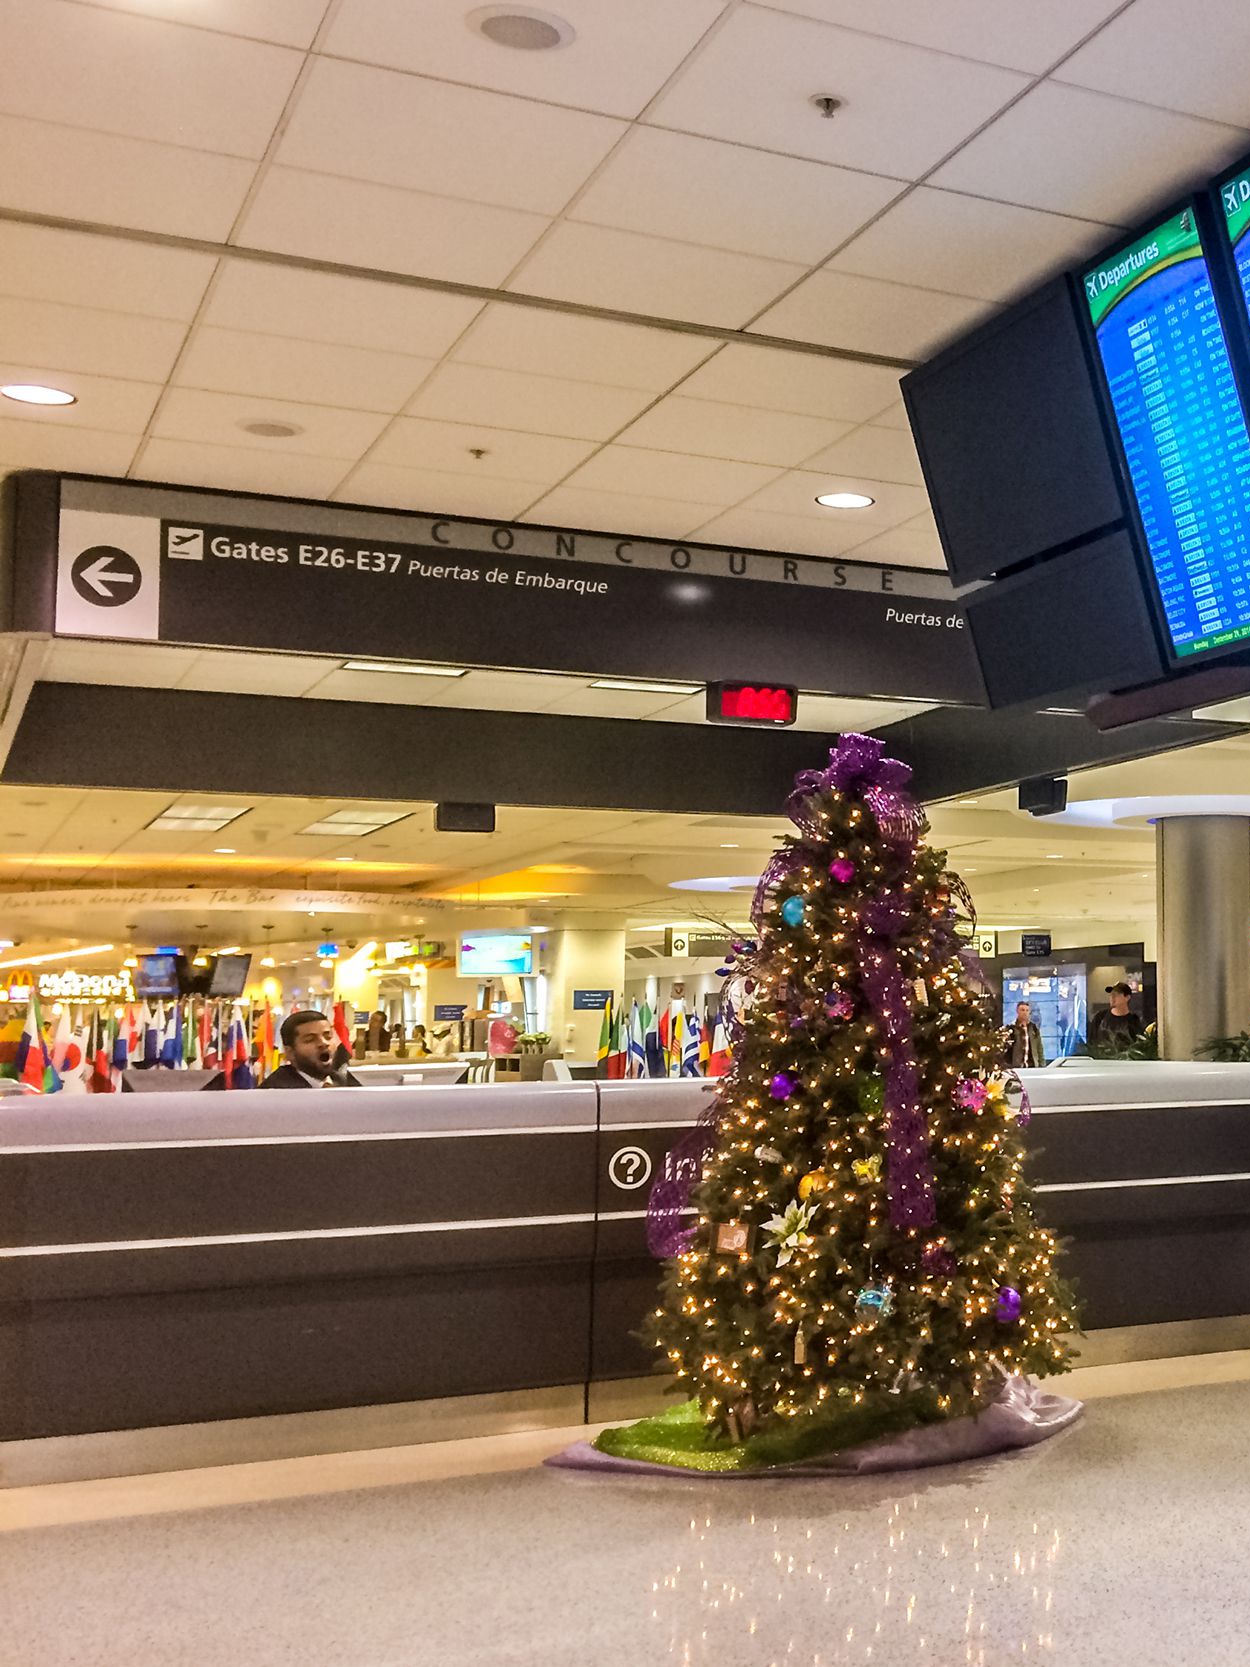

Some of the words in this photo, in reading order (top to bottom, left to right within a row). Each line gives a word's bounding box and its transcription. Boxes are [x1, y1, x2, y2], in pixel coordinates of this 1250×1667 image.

[1098, 241, 1159, 290] Departures
[210, 536, 289, 565] Gates
[298, 545, 402, 575] E26-E37
[407, 559, 480, 582] Puertas
[485, 567, 509, 584] de
[515, 570, 609, 596] Embarque
[431, 521, 894, 592] CONCOURSE
[885, 607, 942, 629] Puertas
[945, 613, 965, 630] de
